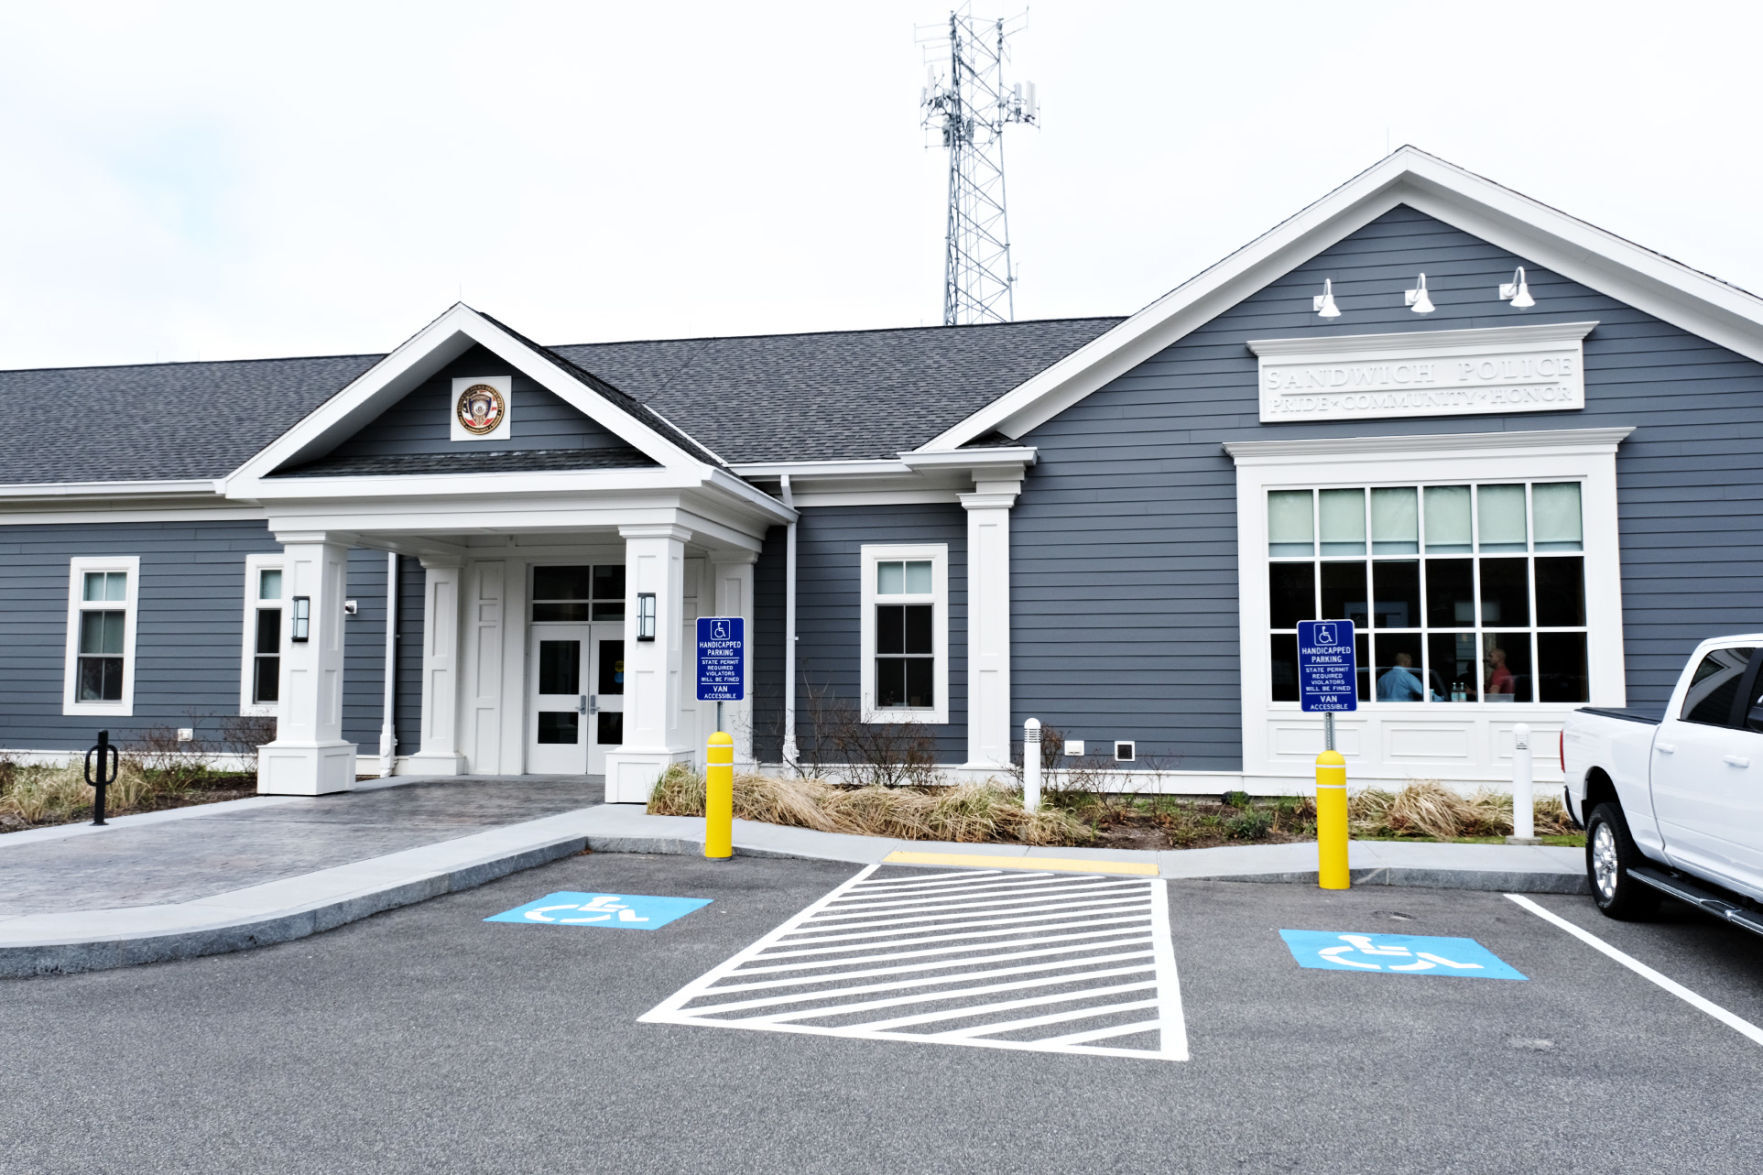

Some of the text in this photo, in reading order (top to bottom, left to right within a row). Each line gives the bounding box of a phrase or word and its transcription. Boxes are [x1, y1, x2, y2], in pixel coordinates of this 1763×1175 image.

[1267, 357, 1574, 391] SANDWICH POLICE
[1270, 386, 1573, 414] PRIDE COMMUNITY HONOR
[1301, 647, 1351, 655] HANDICAPPED
